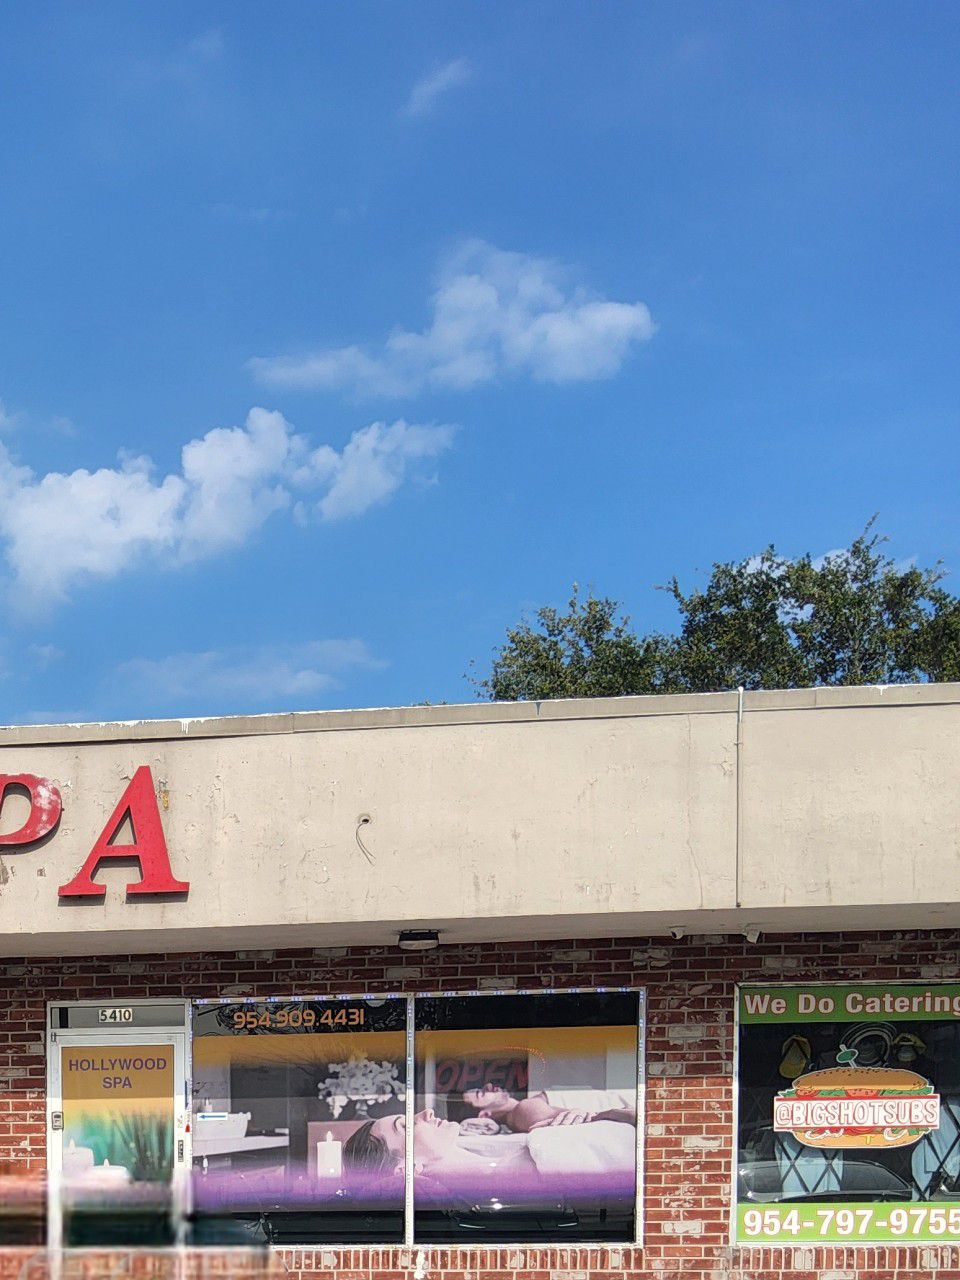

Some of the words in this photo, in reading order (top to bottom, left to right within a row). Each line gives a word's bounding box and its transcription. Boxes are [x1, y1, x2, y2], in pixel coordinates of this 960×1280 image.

[744, 994, 787, 1015] We
[798, 993, 835, 1014] Do
[100, 1008, 132, 1022] 5410
[233, 1008, 365, 1028] 954.909.4431
[68, 1057, 167, 1072] HOLLYWOOD
[102, 1076, 133, 1089] SPA
[775, 1100, 938, 1126] @BIGSHOTSUBS
[744, 1208, 960, 1235] 954-797-9755
